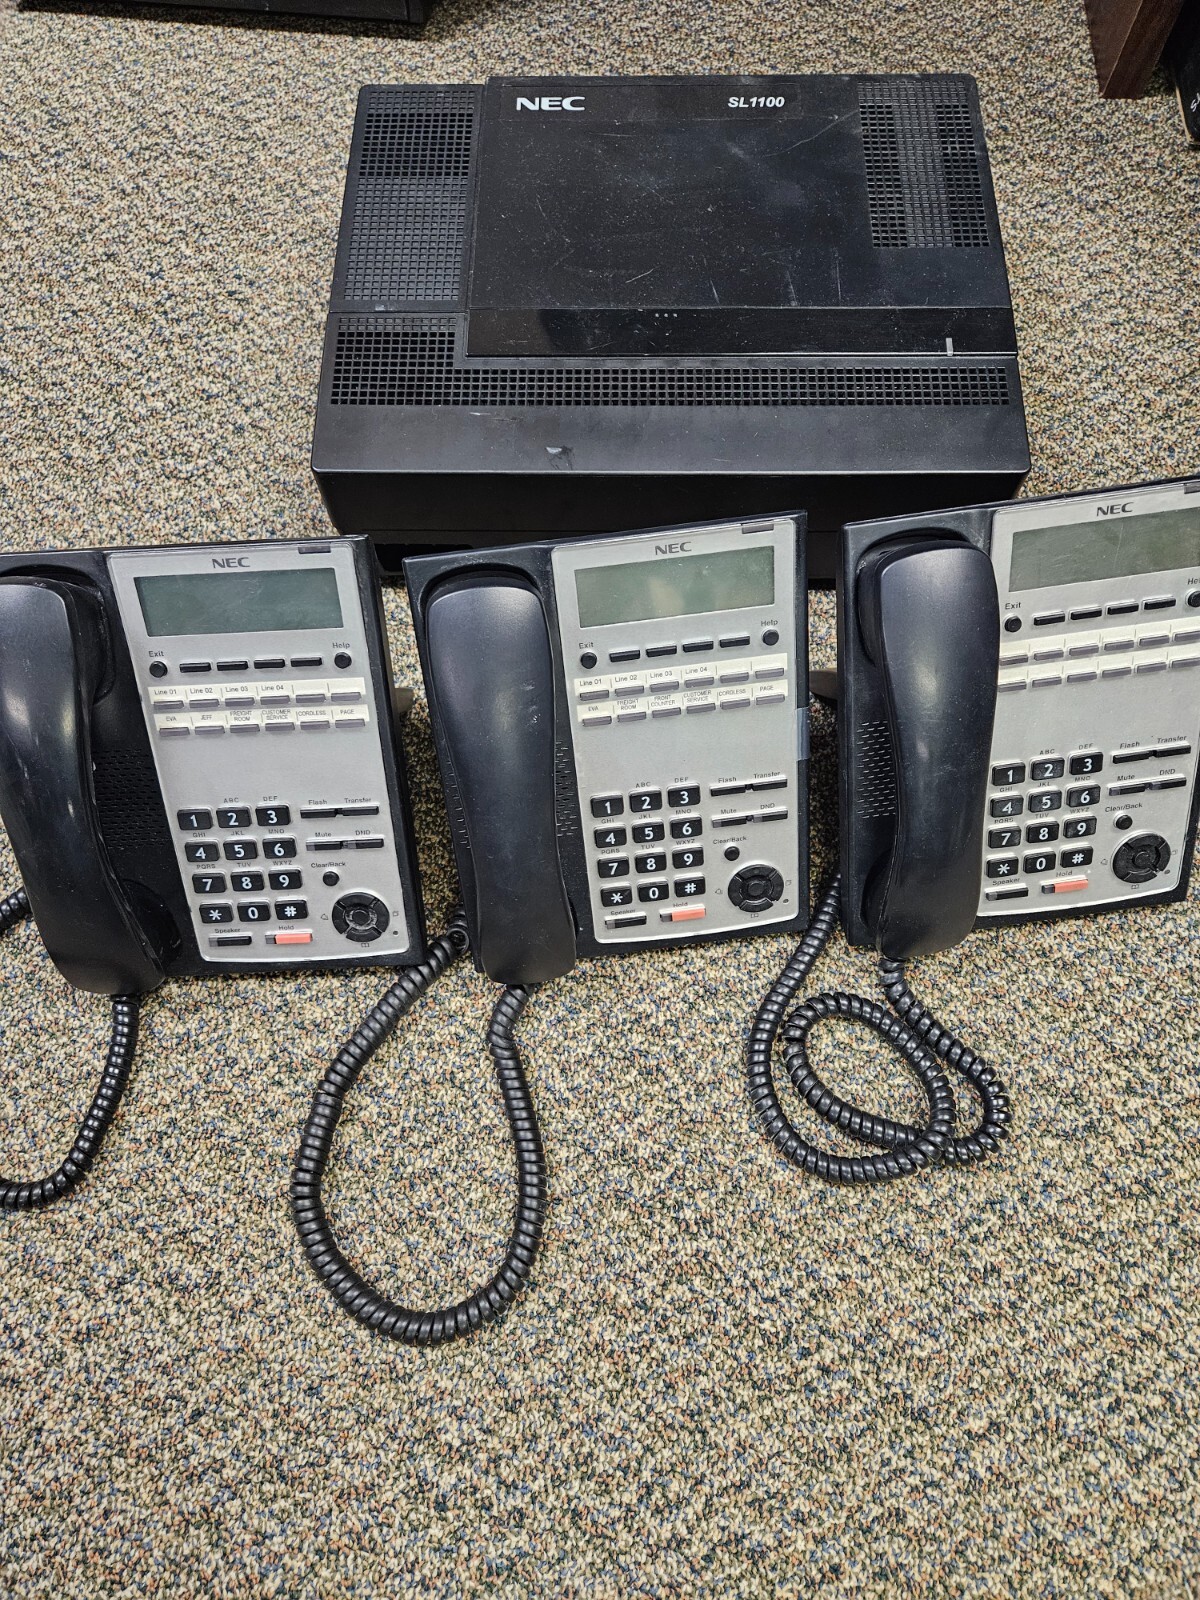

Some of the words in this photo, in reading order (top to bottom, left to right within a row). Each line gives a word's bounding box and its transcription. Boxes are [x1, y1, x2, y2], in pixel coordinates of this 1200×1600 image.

[516, 96, 585, 111] NEC
[728, 96, 785, 108] SL1100
[1096, 502, 1134, 516] NEC
[654, 541, 692, 556] NEC
[212, 557, 250, 569] NEC
[1005, 602, 1022, 610] Exit
[760, 619, 778, 627] Help
[579, 641, 594, 649] Exit
[684, 690, 711, 698] CUSTOMER
[1120, 741, 1140, 749] Flash
[1157, 735, 1187, 744] Transfer
[1044, 765, 1053, 777] 2
[1083, 759, 1093, 771] 3
[753, 771, 780, 779] Transfer
[1007, 770, 1013, 783] 1
[1117, 773, 1135, 781] Mute
[641, 797, 651, 809] 2
[680, 791, 689, 804] 3
[1042, 797, 1051, 809] 5
[1080, 791, 1090, 803] 6
[605, 802, 612, 814] 1
[1002, 802, 1013, 814] 4
[1105, 802, 1143, 812] Clear/Back
[190, 815, 198, 827] 1
[227, 813, 238, 826] 2
[268, 810, 278, 823] 3
[644, 828, 654, 840] 5
[683, 823, 692, 835] 6
[1039, 828, 1049, 840] 8
[1077, 822, 1086, 835] 9
[605, 833, 615, 845] 4
[1001, 833, 1012, 845] 7
[195, 847, 206, 860] 4
[234, 845, 244, 857] 5
[274, 843, 284, 856] 6
[647, 858, 656, 871] 8
[684, 853, 693, 865] 9
[1036, 858, 1046, 870] 0
[609, 863, 618, 875] 7
[202, 879, 212, 891] 7
[242, 877, 252, 889] 8
[279, 875, 290, 887] 9
[992, 877, 1020, 885] Speaker
[649, 887, 659, 899] 0
[247, 907, 259, 919] 0
[611, 908, 636, 916] Speaker
